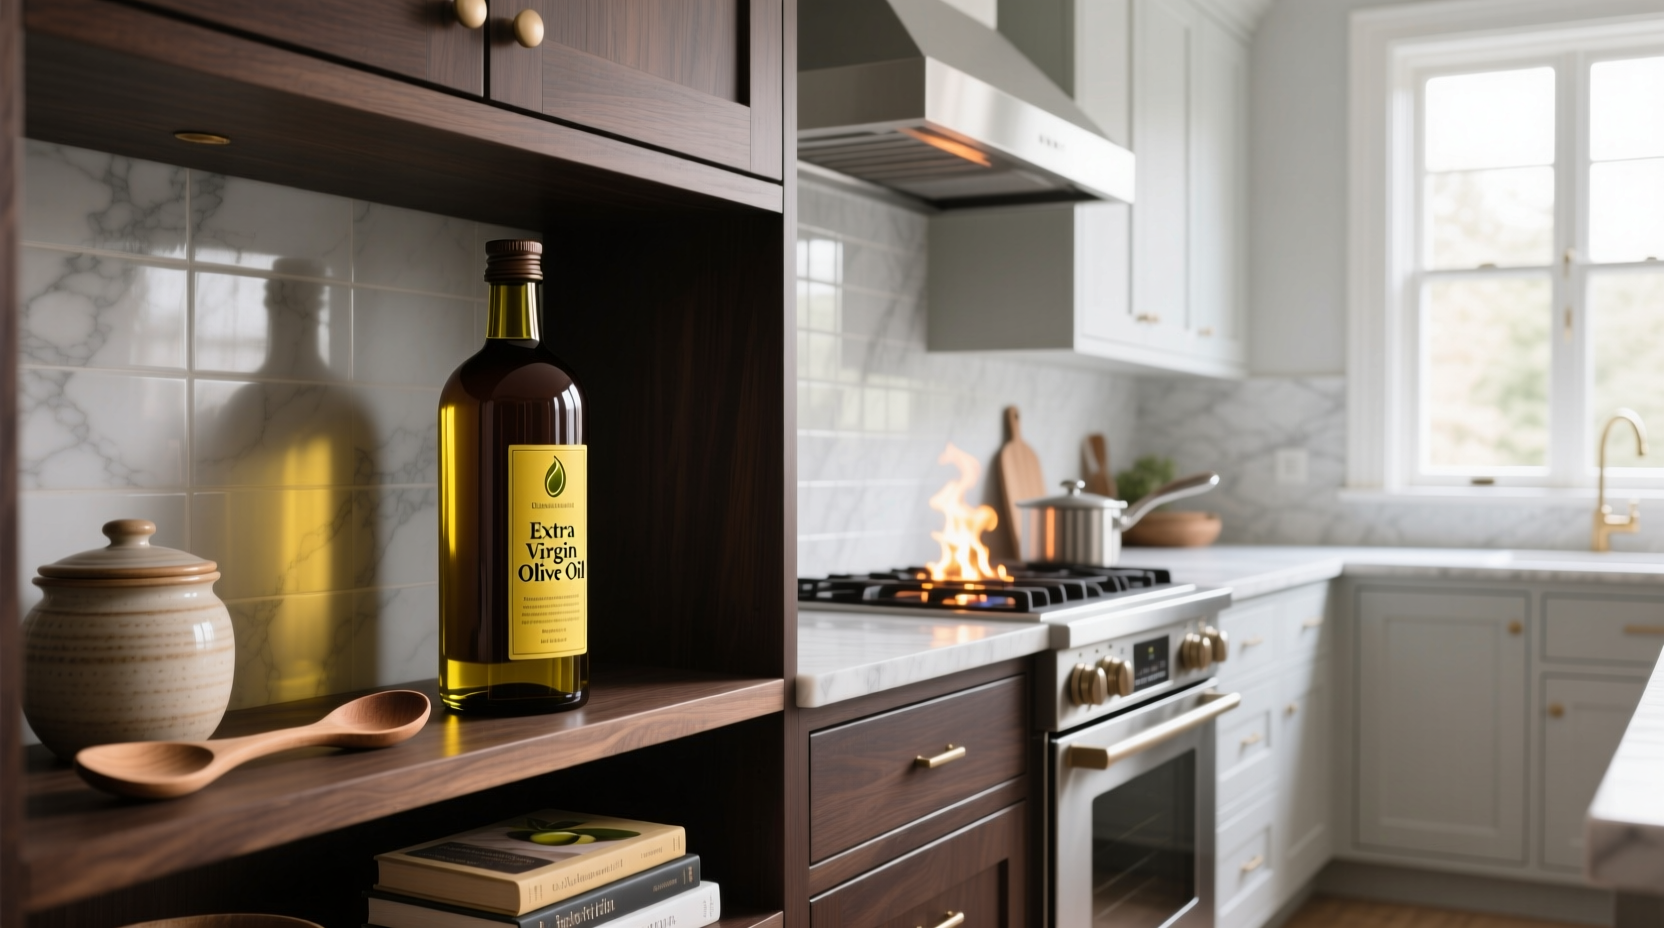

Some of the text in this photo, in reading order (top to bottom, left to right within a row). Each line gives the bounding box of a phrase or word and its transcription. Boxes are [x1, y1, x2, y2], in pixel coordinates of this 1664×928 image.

[530, 522, 574, 539] Extra
[525, 542, 577, 564] Virgin
[518, 560, 585, 582] Olive Oil
